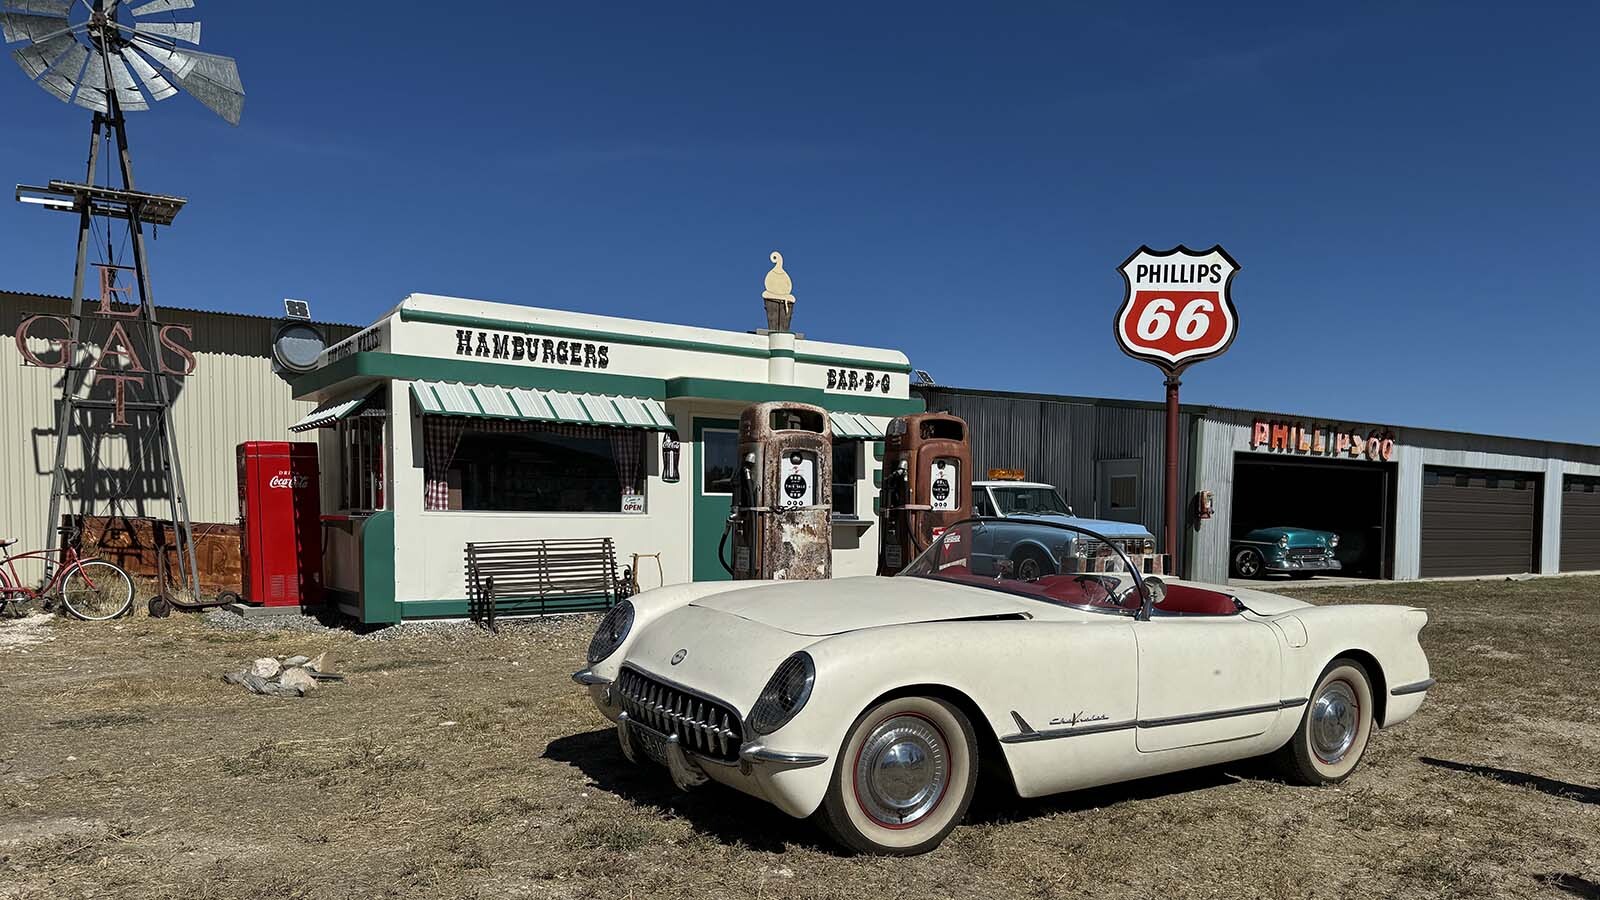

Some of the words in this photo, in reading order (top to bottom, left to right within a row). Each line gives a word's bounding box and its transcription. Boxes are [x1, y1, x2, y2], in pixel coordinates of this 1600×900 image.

[1136, 263, 1222, 284] PHILLIPS
[1136, 298, 1215, 342] 66
[15, 312, 197, 377] GAS
[455, 329, 609, 369] HAMBURGERS
